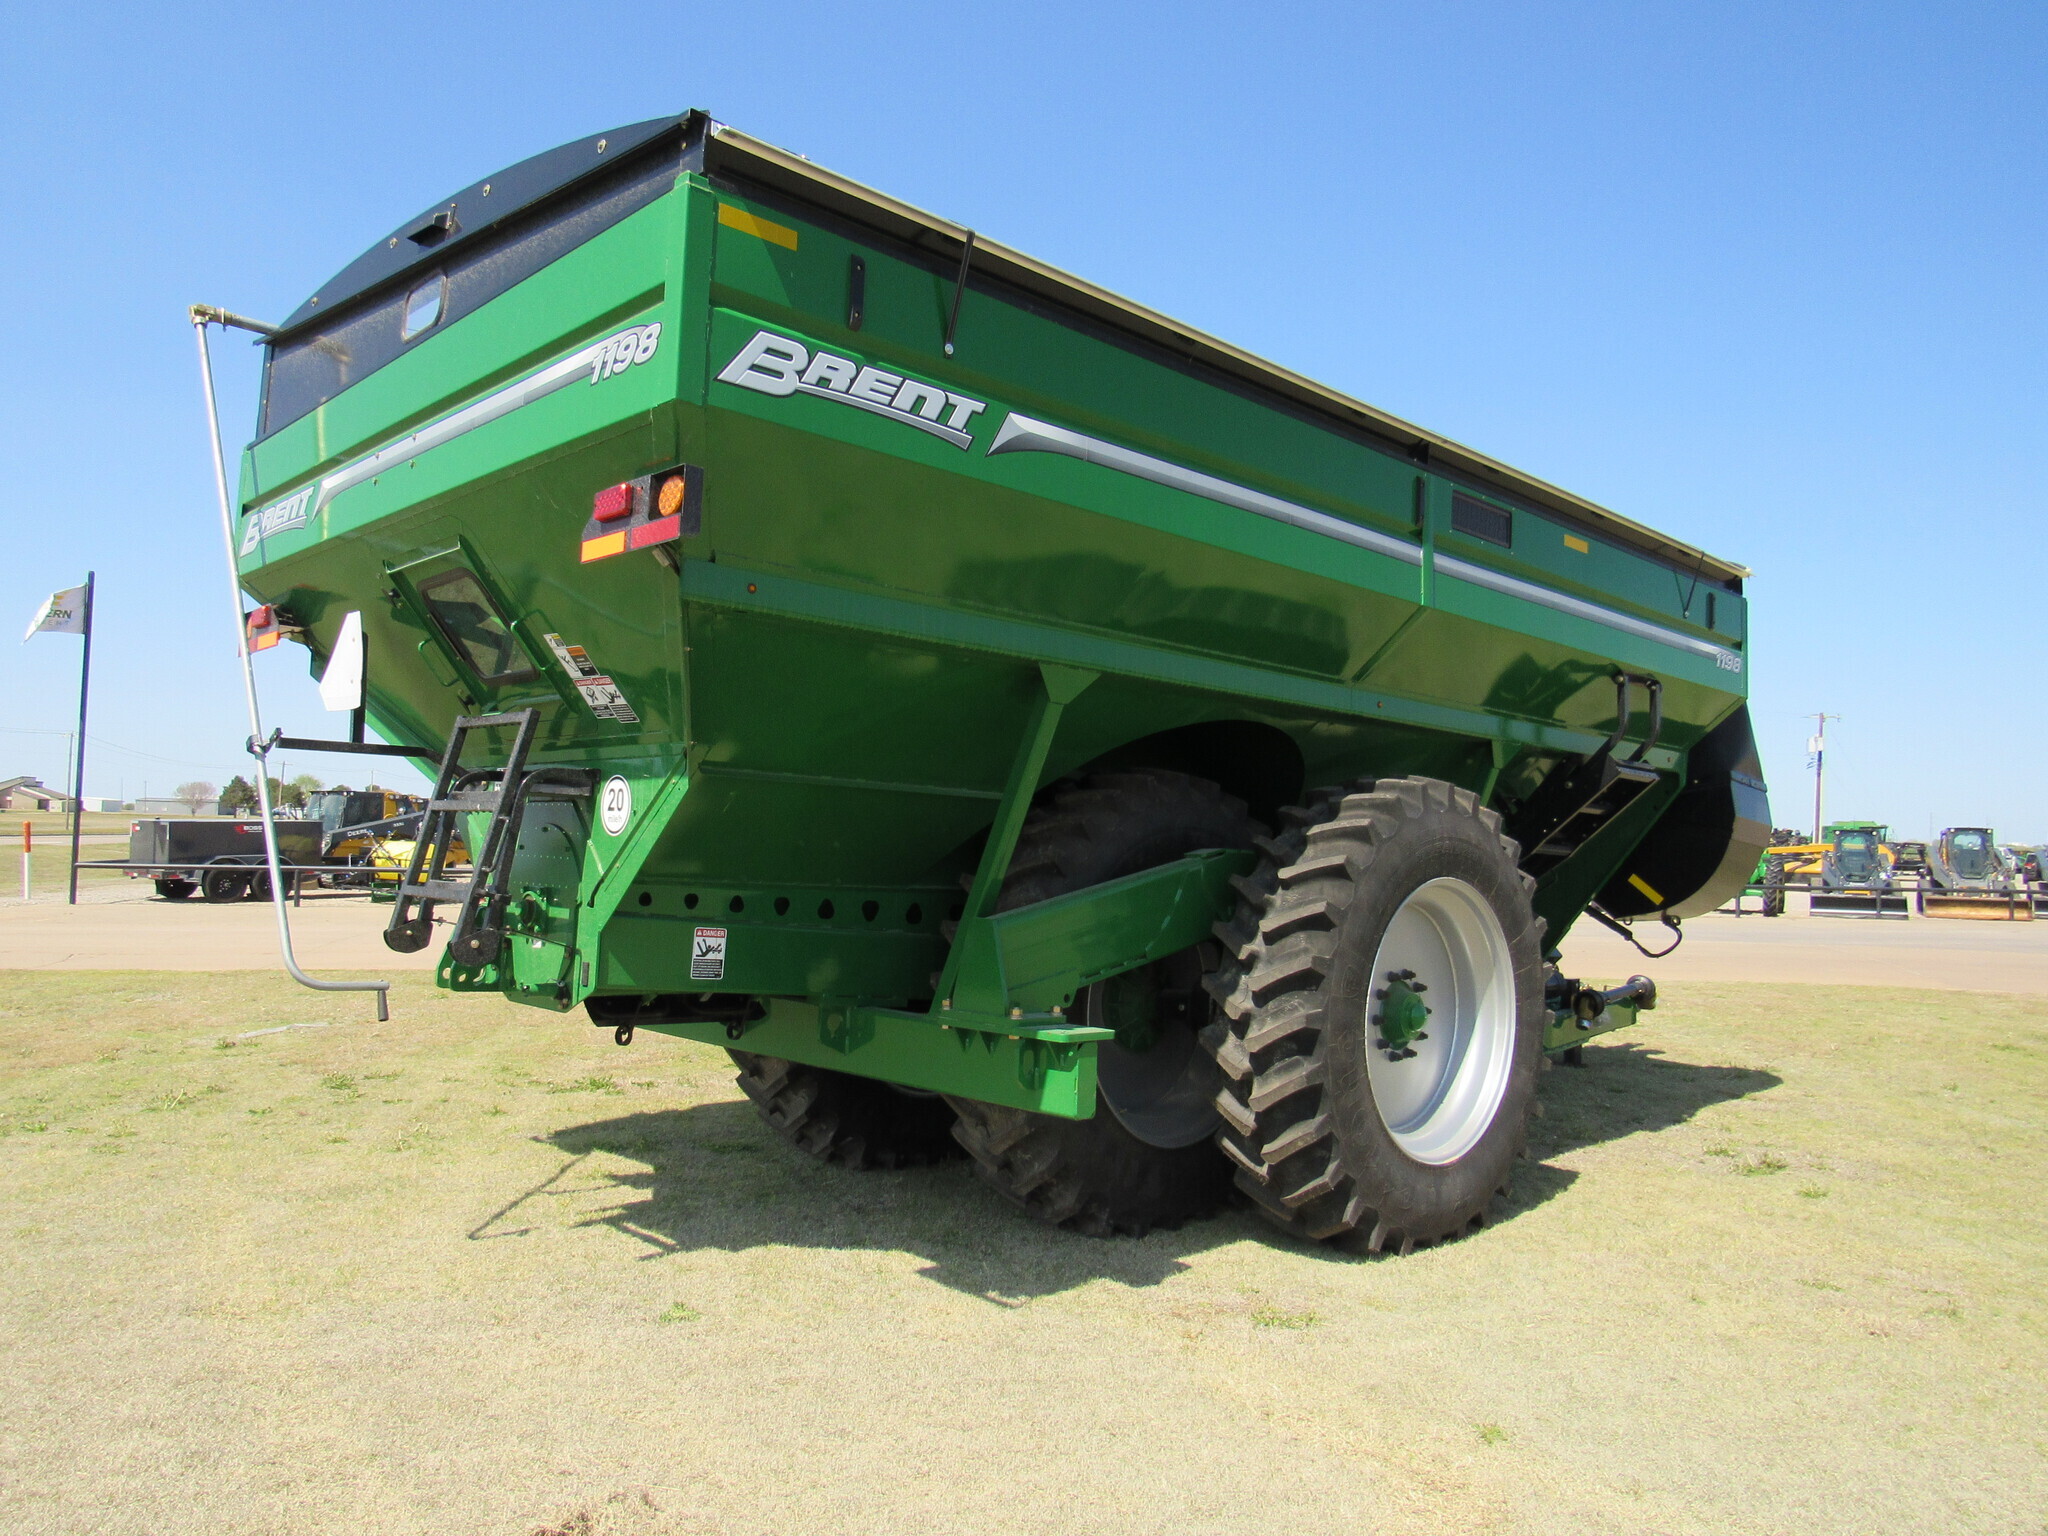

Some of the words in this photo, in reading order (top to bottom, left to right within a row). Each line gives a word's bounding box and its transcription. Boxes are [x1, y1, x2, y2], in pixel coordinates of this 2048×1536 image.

[590, 322, 662, 386] 1198
[1716, 652, 1742, 673] 1198
[608, 788, 624, 811] 20
